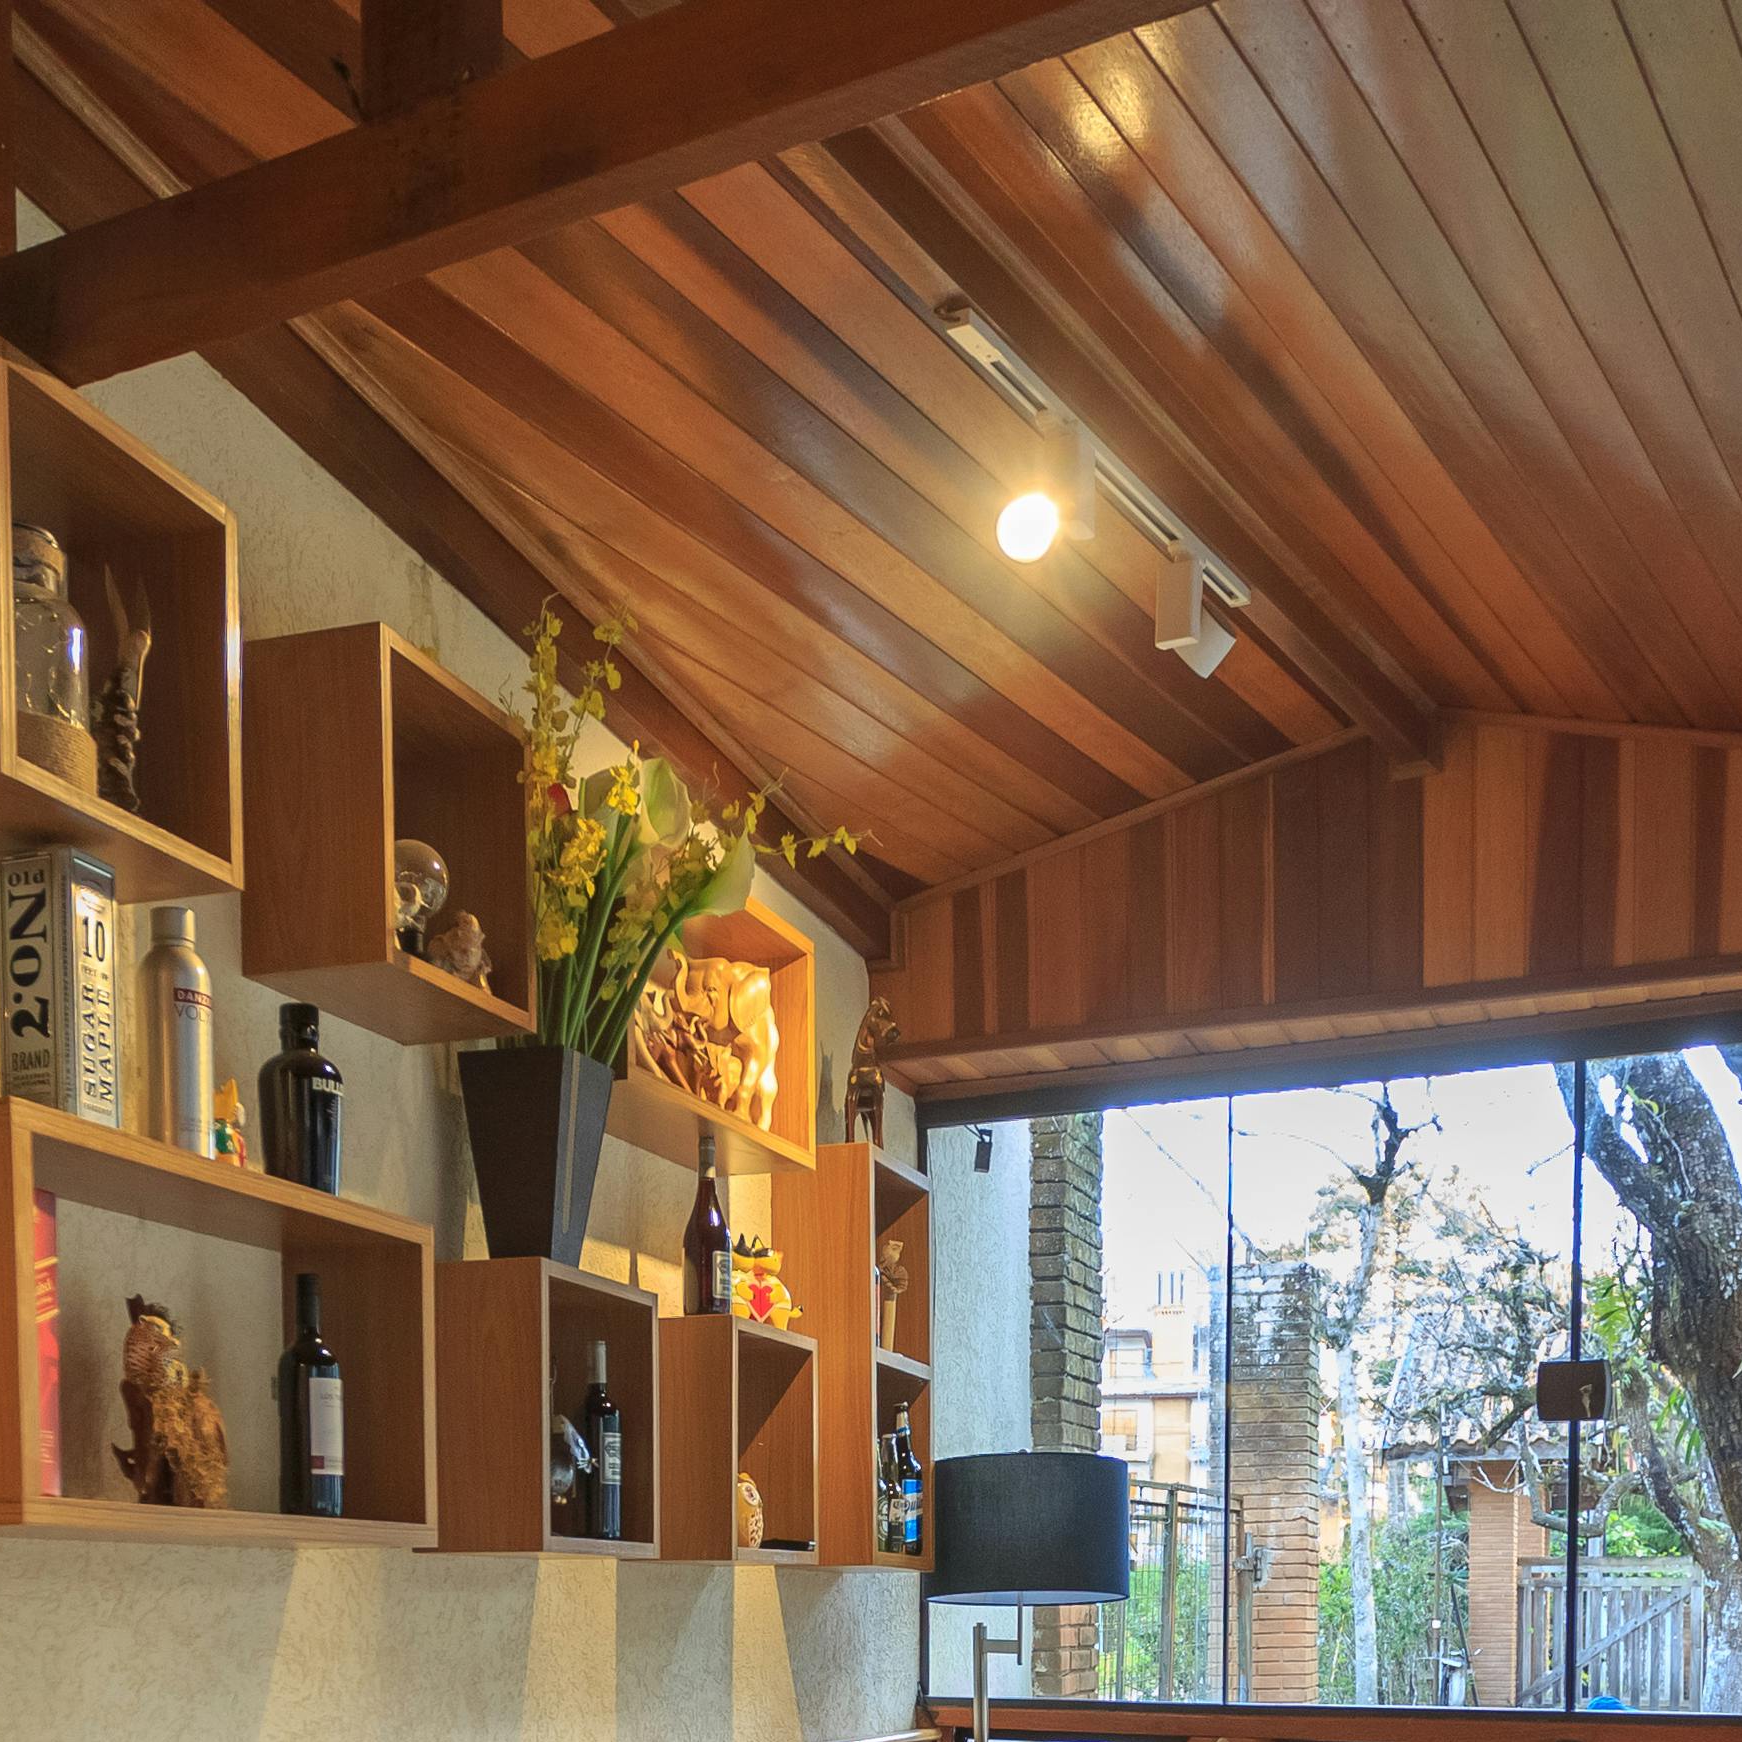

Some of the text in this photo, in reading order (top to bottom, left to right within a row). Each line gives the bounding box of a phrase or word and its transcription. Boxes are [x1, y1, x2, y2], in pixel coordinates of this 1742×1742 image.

[8, 869, 46, 888] Old
[82, 916, 107, 963] 10
[11, 1049, 51, 1072] BRAND
[82, 983, 97, 1097] SUGAR
[96, 989, 112, 1104] MAPLE
